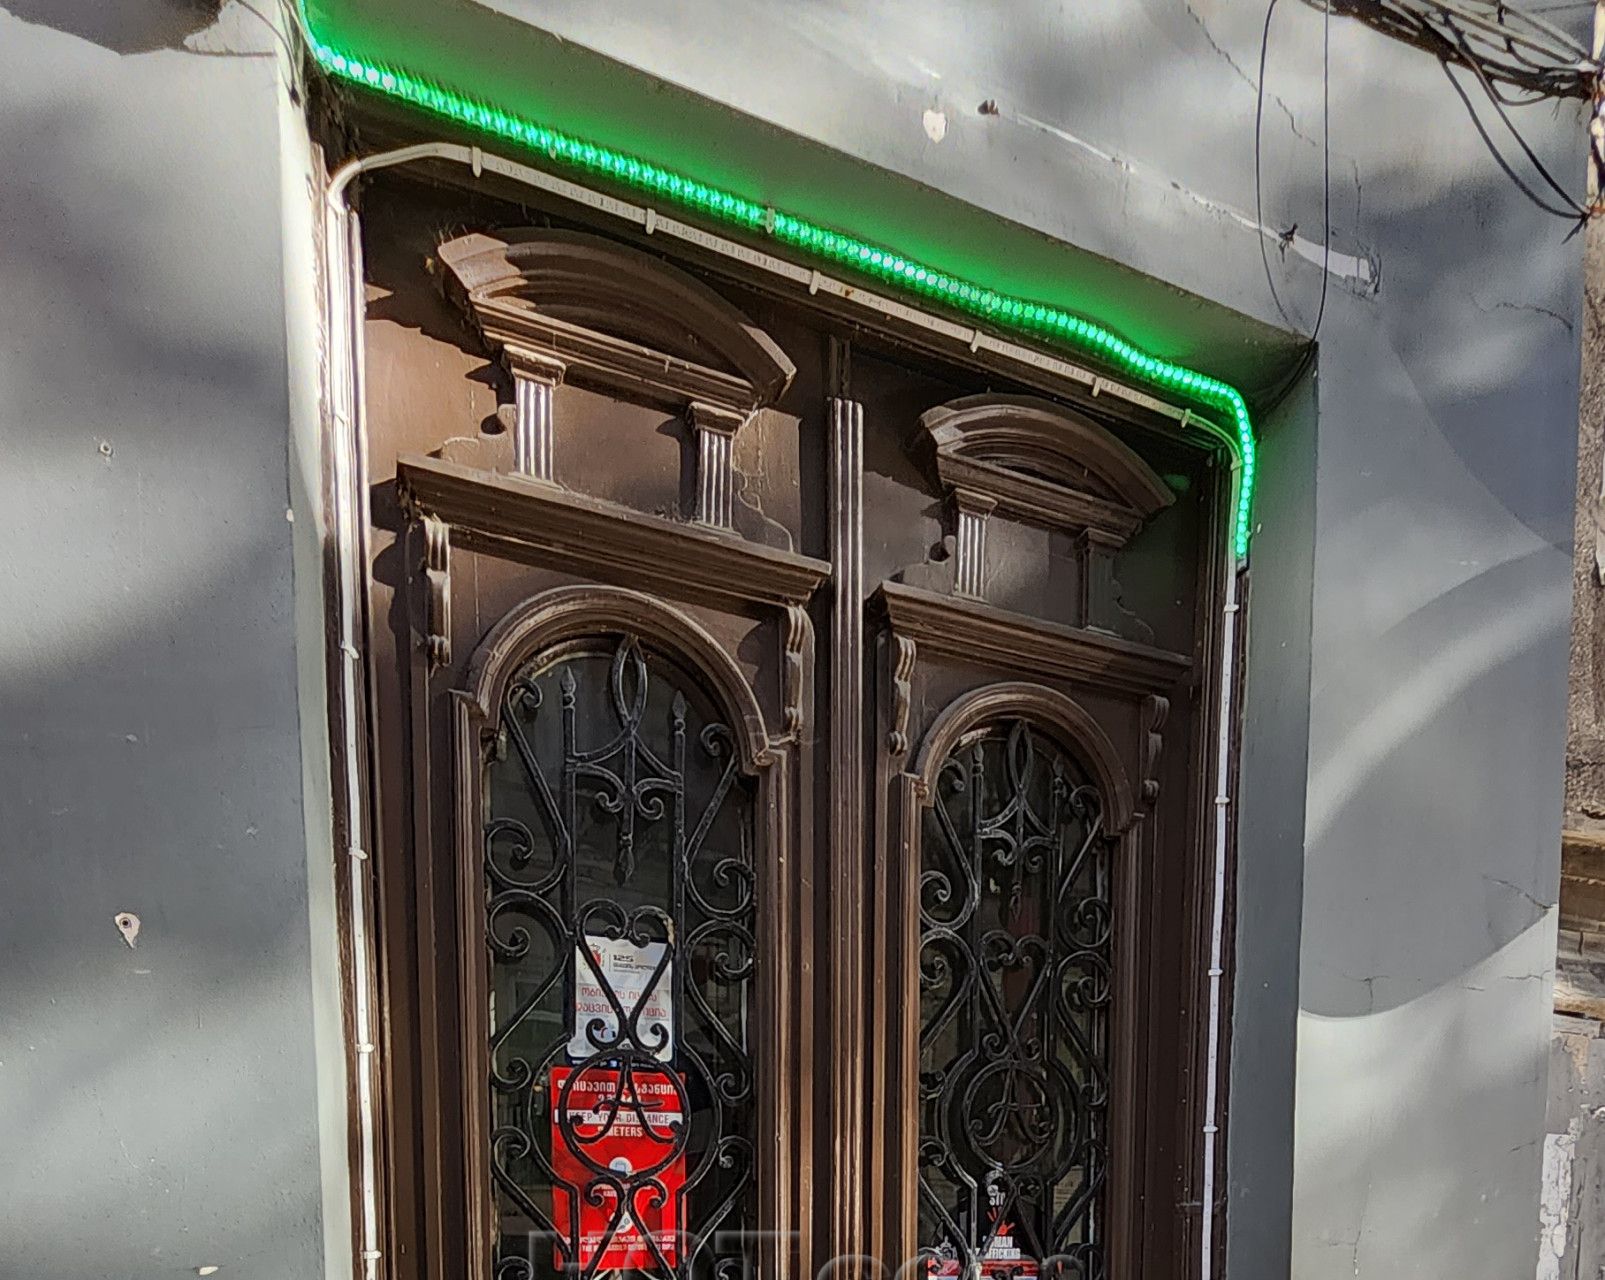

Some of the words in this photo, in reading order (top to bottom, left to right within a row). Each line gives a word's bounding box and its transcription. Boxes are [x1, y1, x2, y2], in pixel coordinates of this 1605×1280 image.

[557, 1080, 616, 1093] დიცავით
[621, 1082, 678, 1096] სტანცი
[598, 1113, 622, 1123] YOR
[626, 1113, 669, 1124] DIANCE
[982, 1235, 1013, 1248] MAN
